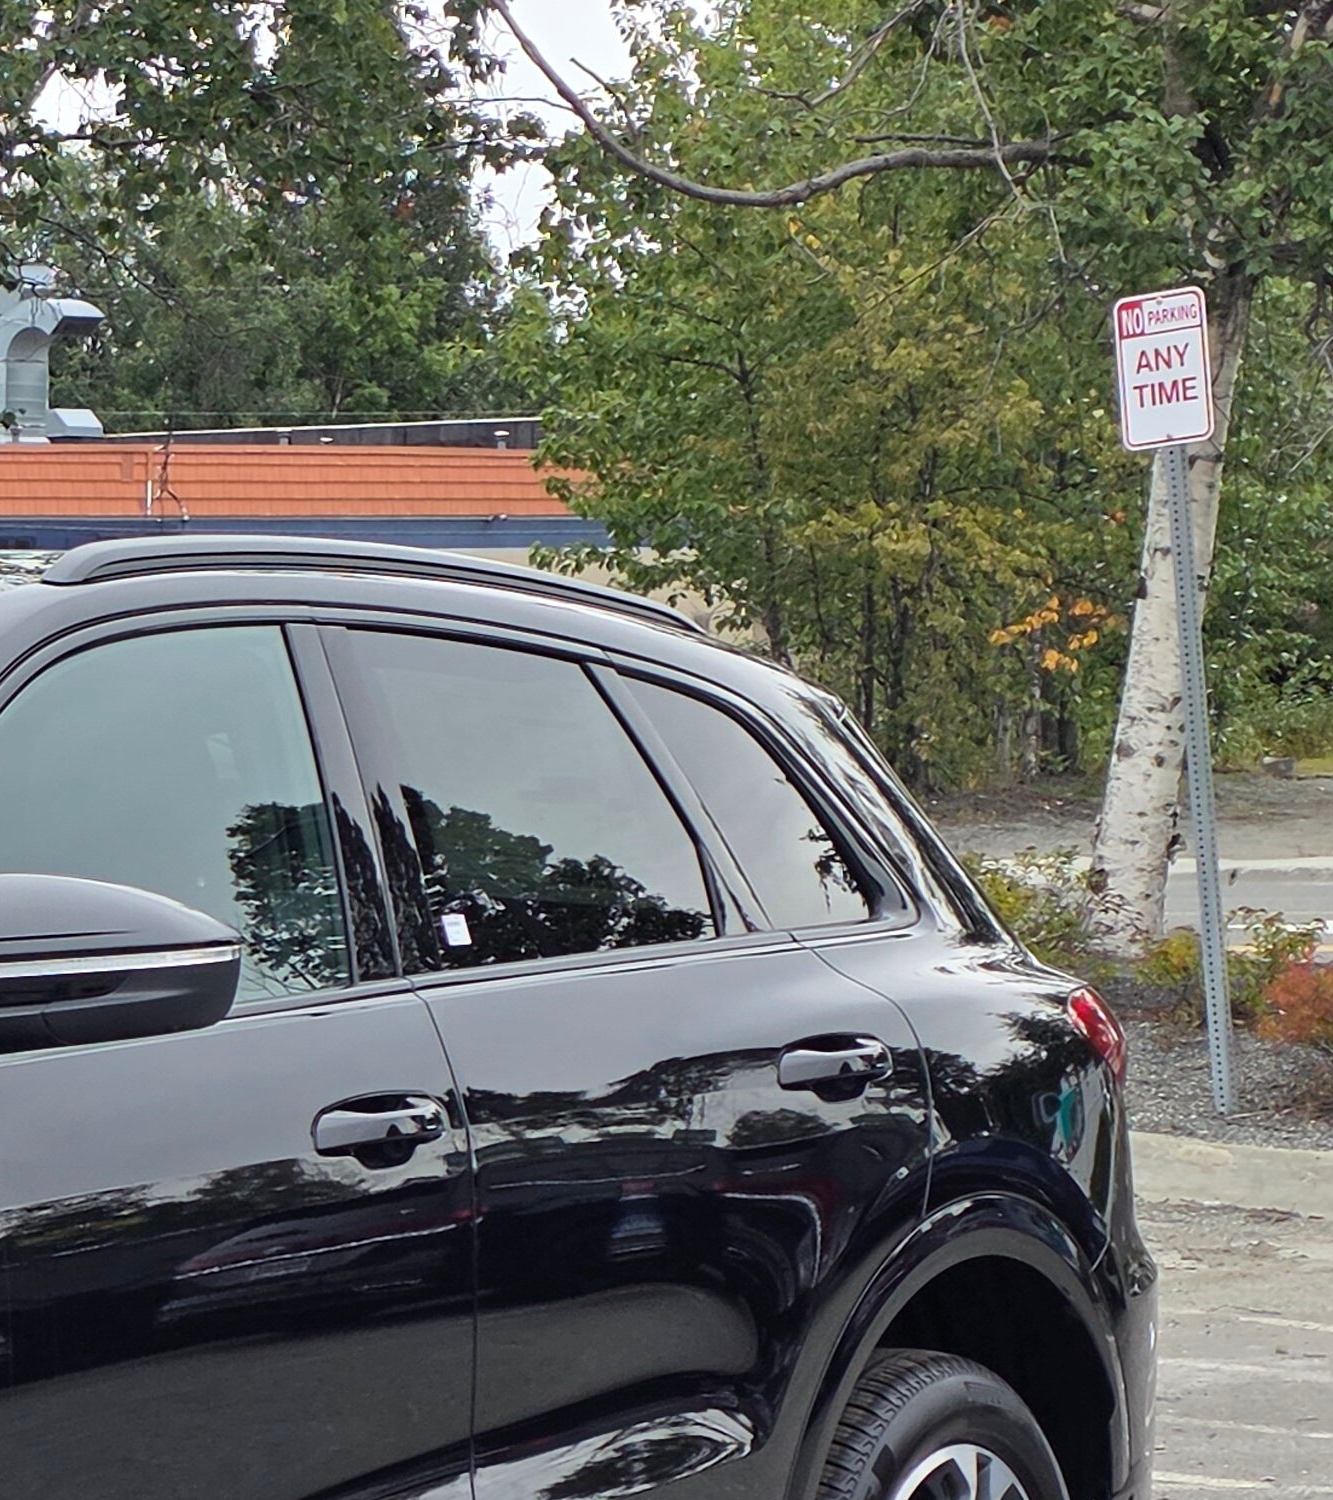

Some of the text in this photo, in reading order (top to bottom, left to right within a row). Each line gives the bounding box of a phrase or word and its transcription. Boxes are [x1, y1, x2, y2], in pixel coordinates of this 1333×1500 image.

[1121, 303, 1198, 336] NO PARKING
[1136, 342, 1190, 374] ANY
[1133, 376, 1199, 408] TIME
